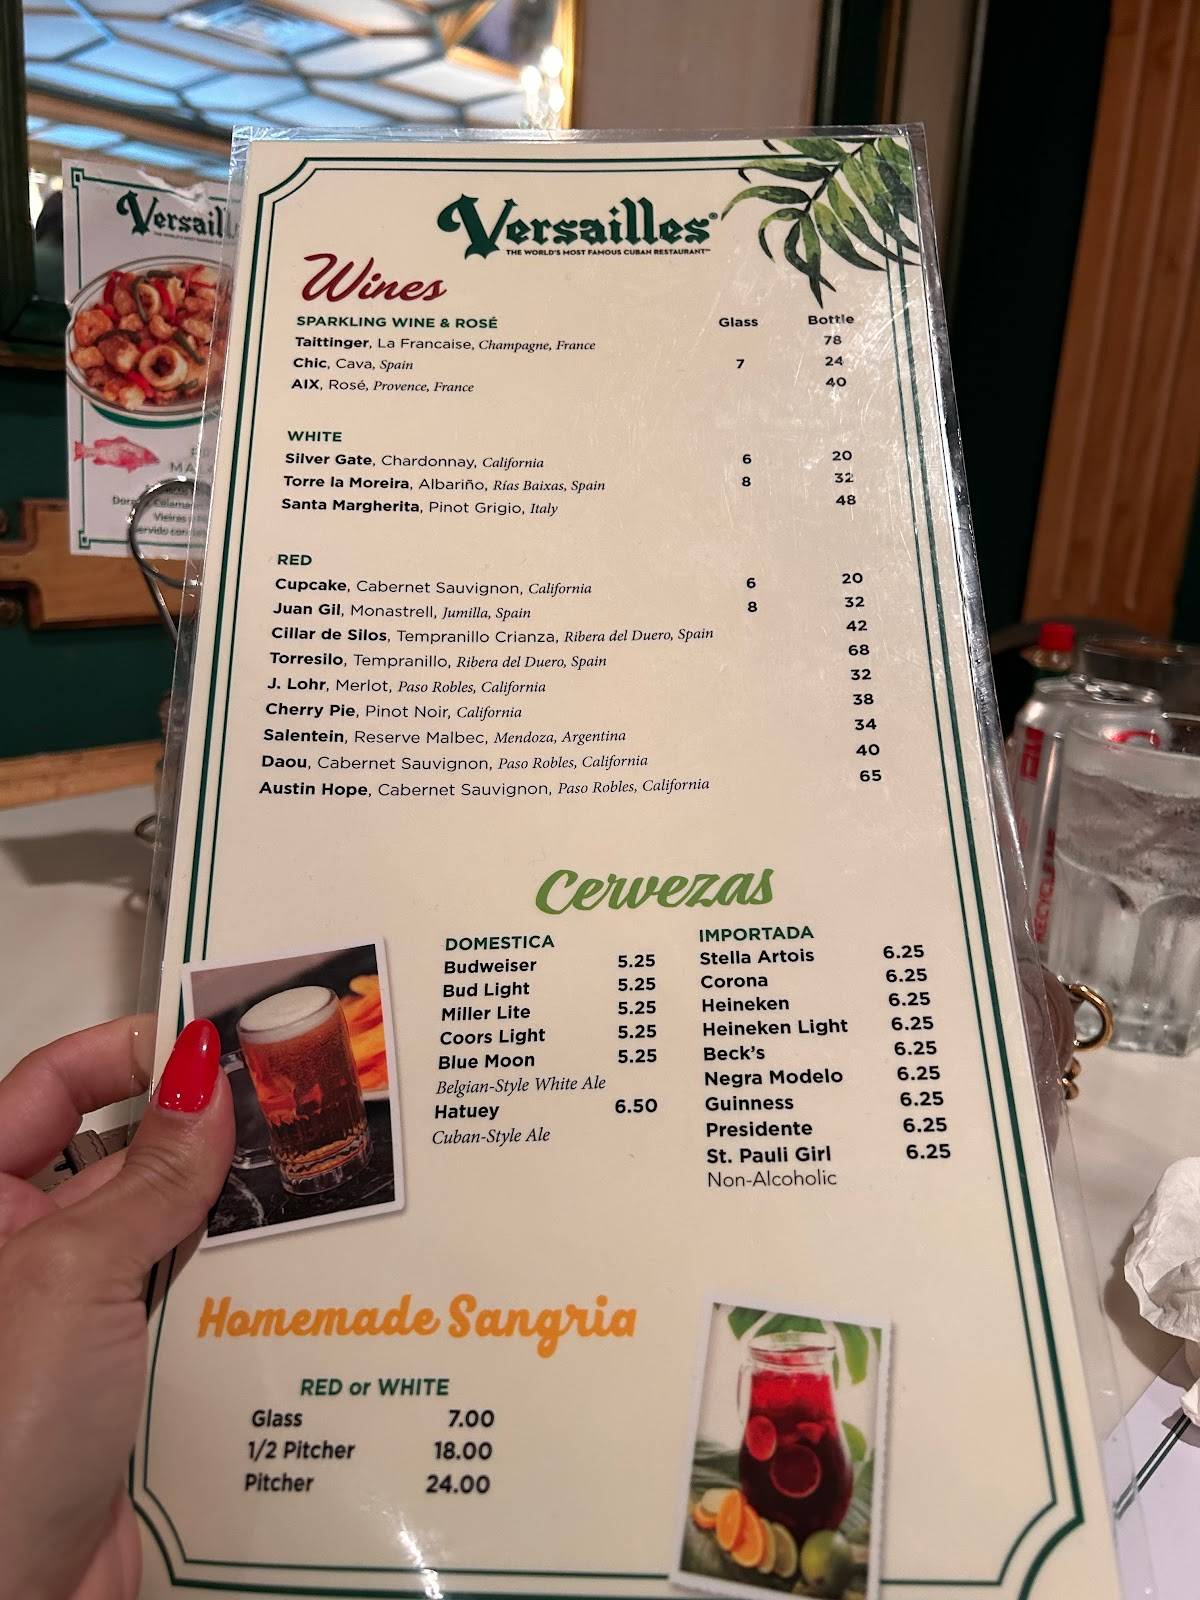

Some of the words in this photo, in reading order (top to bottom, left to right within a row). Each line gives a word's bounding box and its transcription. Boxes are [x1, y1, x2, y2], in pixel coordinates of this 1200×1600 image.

[300, 252, 448, 303] Wines
[296, 315, 387, 328] SPARKLING
[391, 316, 436, 329] WINE
[439, 317, 451, 329] &
[454, 316, 499, 329] ROSÉ
[718, 316, 759, 328] Glass
[807, 313, 855, 326] Bottle
[294, 336, 373, 350] Taittinger,
[377, 337, 396, 349] La
[400, 337, 475, 351] Francaise,
[478, 339, 553, 354] Champagne,
[555, 339, 596, 354] France
[823, 334, 843, 346] 78
[292, 356, 331, 371] Chic,
[335, 357, 376, 371] Cava,
[379, 359, 414, 373] Spain
[735, 358, 745, 370] 7
[824, 355, 845, 367] 24
[290, 378, 323, 392] AIX,
[328, 378, 369, 392] Rosé,
[372, 380, 430, 393] Provence,
[433, 381, 475, 393] France
[824, 376, 848, 388] 40
[286, 430, 343, 443] WHITE
[284, 452, 331, 465] Silver
[334, 453, 376, 468] Gate,
[381, 454, 477, 470] Chardonnay,
[482, 456, 544, 472] California
[742, 453, 753, 465] 6
[831, 449, 853, 462] 20
[283, 475, 326, 488] Torre
[330, 475, 345, 488] la
[348, 476, 413, 491] Moreira,
[418, 477, 488, 492] Albariño,
[492, 479, 520, 493] Rías
[522, 479, 568, 493] Baixas,
[570, 479, 606, 495] Spain
[741, 475, 752, 488] 8
[834, 471, 855, 484] 32
[280, 497, 328, 511] Santa
[332, 499, 424, 515] Margherita,
[428, 501, 470, 514] Pinot
[474, 501, 525, 516] Grigio,
[529, 502, 559, 518] Italy
[835, 494, 857, 507] 48
[276, 553, 313, 567] RED
[745, 576, 757, 590] 6
[841, 572, 864, 585] 20
[274, 577, 351, 593] Cupcake,
[356, 579, 431, 594] Cabernet
[435, 581, 524, 597] Sauvignon,
[528, 581, 593, 598] California
[747, 600, 758, 613] 8
[844, 595, 865, 609] 32
[272, 601, 313, 615] Juan
[317, 603, 345, 618] Gil,
[350, 603, 437, 620] Monastrell,
[441, 606, 492, 621] Jumilla,
[495, 607, 531, 623] Spain
[845, 619, 868, 632] 42
[271, 626, 317, 640] Cillar
[320, 627, 343, 641] de
[347, 628, 391, 644] Silos,
[396, 629, 490, 645] Tempranillo
[494, 630, 559, 645] Crianza,
[563, 629, 606, 643] Ribera
[608, 629, 628, 643] del
[631, 629, 674, 642] Duero,
[677, 627, 714, 644] Spain
[852, 692, 875, 706] 38
[265, 702, 325, 719] Cherry
[329, 703, 360, 719] Pie,
[365, 704, 409, 718] Pinot
[414, 705, 451, 720] Noir,
[456, 705, 523, 722] California
[859, 769, 882, 783] 65
[258, 781, 316, 796] Austin
[321, 782, 372, 799] Hope,
[377, 783, 456, 797] Cabernet
[460, 783, 552, 798] Sauvignon,
[557, 782, 589, 795] Paso
[591, 779, 638, 794] Robles,
[642, 777, 710, 795] California
[534, 867, 775, 916] Cervezas
[699, 925, 815, 943] IMPORTADA
[445, 934, 556, 952] DOMESTICA
[699, 949, 752, 966] Stella
[757, 947, 816, 964] Artois
[882, 944, 925, 960] 6.25
[443, 958, 538, 975] Budweiser
[617, 953, 656, 969] 5.25
[617, 976, 657, 992] 5.25
[700, 974, 769, 989] Corona
[885, 967, 928, 984] 6.25
[442, 982, 479, 998] Bud
[483, 981, 531, 999] Light
[617, 1023, 657, 1040] 5.25
[702, 1020, 792, 1037] Heineken
[797, 1018, 849, 1037] Light
[890, 1015, 935, 1032] 6.25
[439, 1031, 493, 1046] Coors
[498, 1027, 546, 1046] Light
[617, 1048, 658, 1065] 5.25
[703, 1045, 766, 1062] Beck's
[893, 1040, 938, 1057] 6.25
[438, 1054, 479, 1071] Blue
[484, 1053, 535, 1069] Moon
[704, 1071, 763, 1089] Negra
[768, 1067, 844, 1085] Modelo
[896, 1064, 941, 1082] 6.25
[434, 1077, 530, 1099] Belgian-Style
[534, 1074, 579, 1091] White
[580, 1074, 607, 1091] Ale
[614, 1097, 658, 1115] 6.50
[704, 1095, 795, 1112] Guinness
[899, 1090, 945, 1108] 6.25
[434, 1104, 501, 1121] Hatuey
[705, 1120, 814, 1138] Presidente
[902, 1116, 948, 1134] 6.25
[431, 1127, 522, 1148] Cuban-Style
[524, 1126, 551, 1143] Ale
[706, 1147, 733, 1165] St.
[739, 1146, 789, 1164] Pauli
[794, 1144, 832, 1163] Girl
[905, 1143, 952, 1160] 6.25
[707, 1168, 838, 1188] Non-Alcoholic
[197, 1293, 441, 1339] Homemade
[447, 1293, 638, 1360] Sangria
[299, 1377, 344, 1397] RED
[348, 1381, 372, 1397] or
[377, 1377, 451, 1397] WHITE
[250, 1408, 303, 1429] Glass
[447, 1408, 495, 1429] 7.00
[247, 1438, 278, 1463] 1/2
[282, 1439, 357, 1460] Pitcher
[433, 1440, 493, 1462] 18.00
[244, 1471, 315, 1493] Pitcher
[425, 1473, 491, 1496] 24.00
